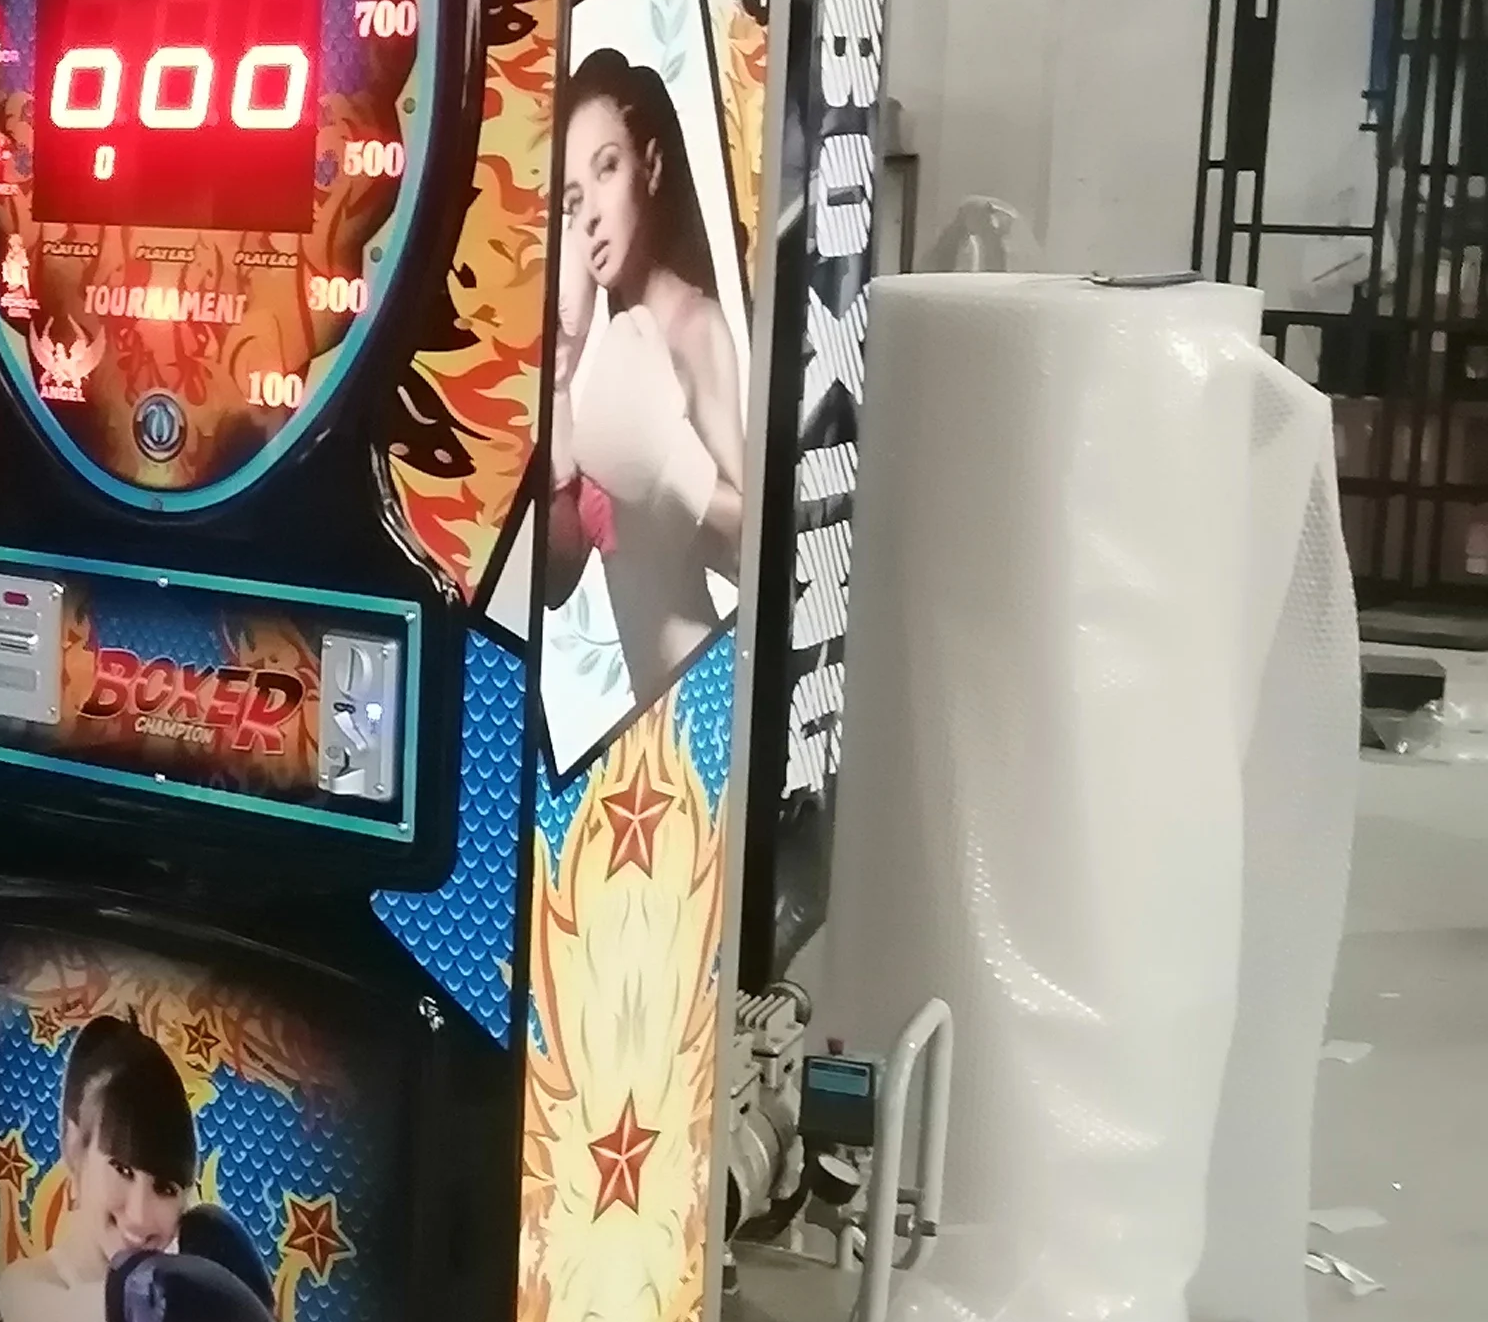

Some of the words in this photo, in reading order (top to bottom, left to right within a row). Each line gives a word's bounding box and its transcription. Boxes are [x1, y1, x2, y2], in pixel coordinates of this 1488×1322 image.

[354, 0, 418, 38] 700
[343, 140, 406, 178] 500
[83, 284, 248, 325] TOURNAMENT
[306, 276, 369, 315] 300
[38, 385, 87, 403] ANGEL
[246, 370, 303, 409] 100
[77, 646, 308, 756] BOXER
[133, 714, 214, 745] CHAMPION
